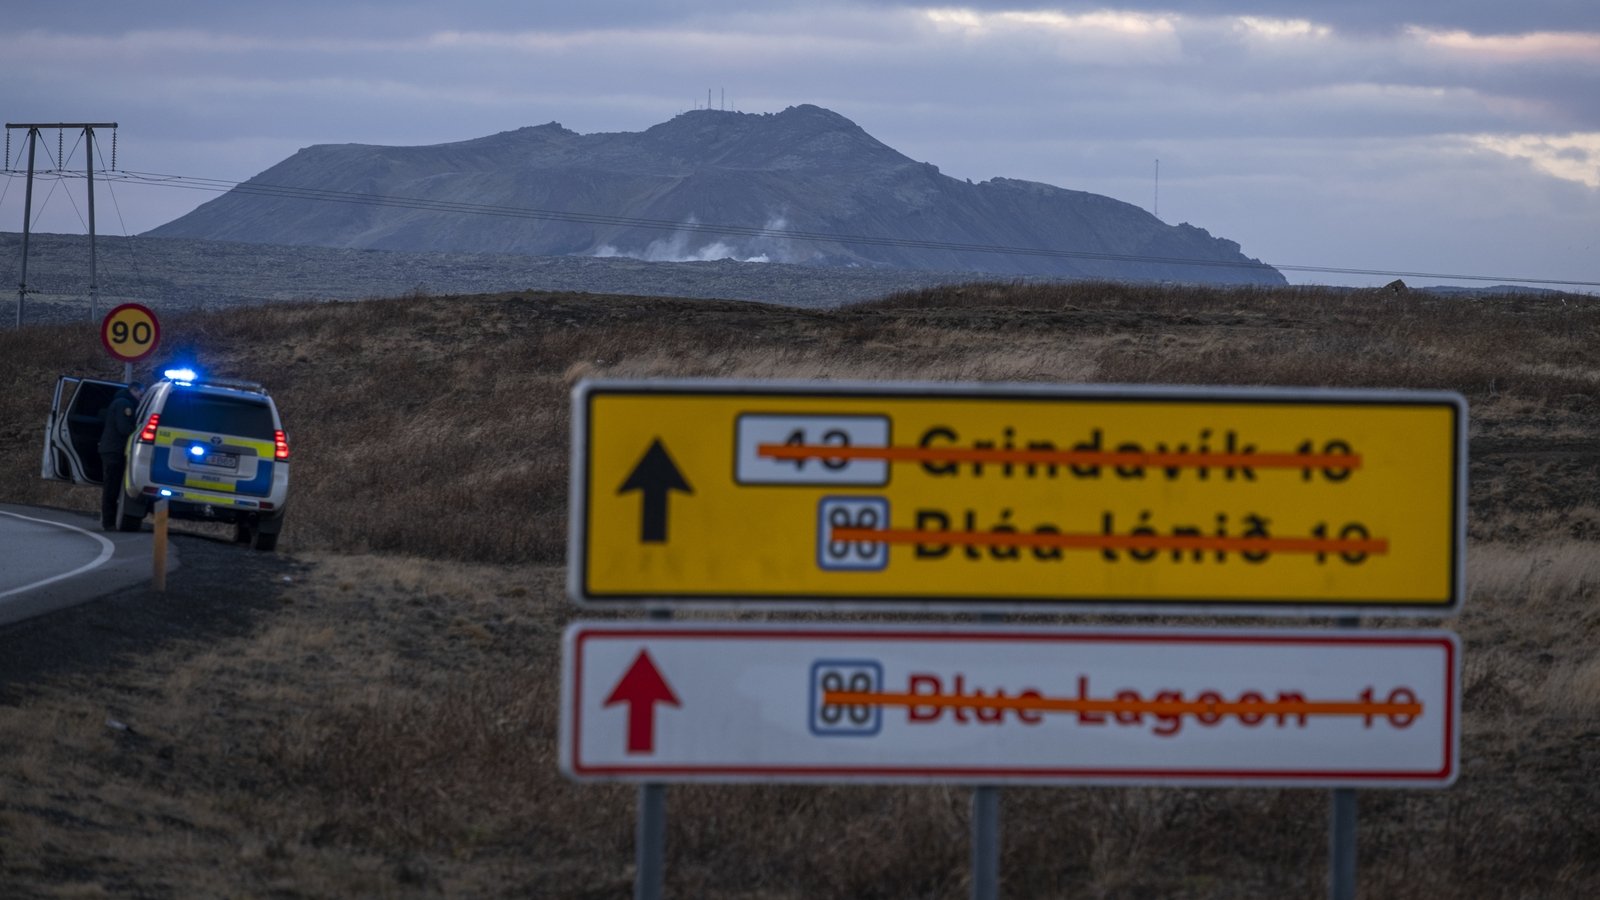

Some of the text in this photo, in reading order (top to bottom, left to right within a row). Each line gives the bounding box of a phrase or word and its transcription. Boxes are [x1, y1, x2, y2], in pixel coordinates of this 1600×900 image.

[112, 321, 152, 344] 90
[774, 428, 850, 473] 43
[918, 425, 1257, 482] Grindavík
[913, 508, 1371, 566] Bláa lónið 10
[907, 674, 1418, 738] Blue Lagoon 10
